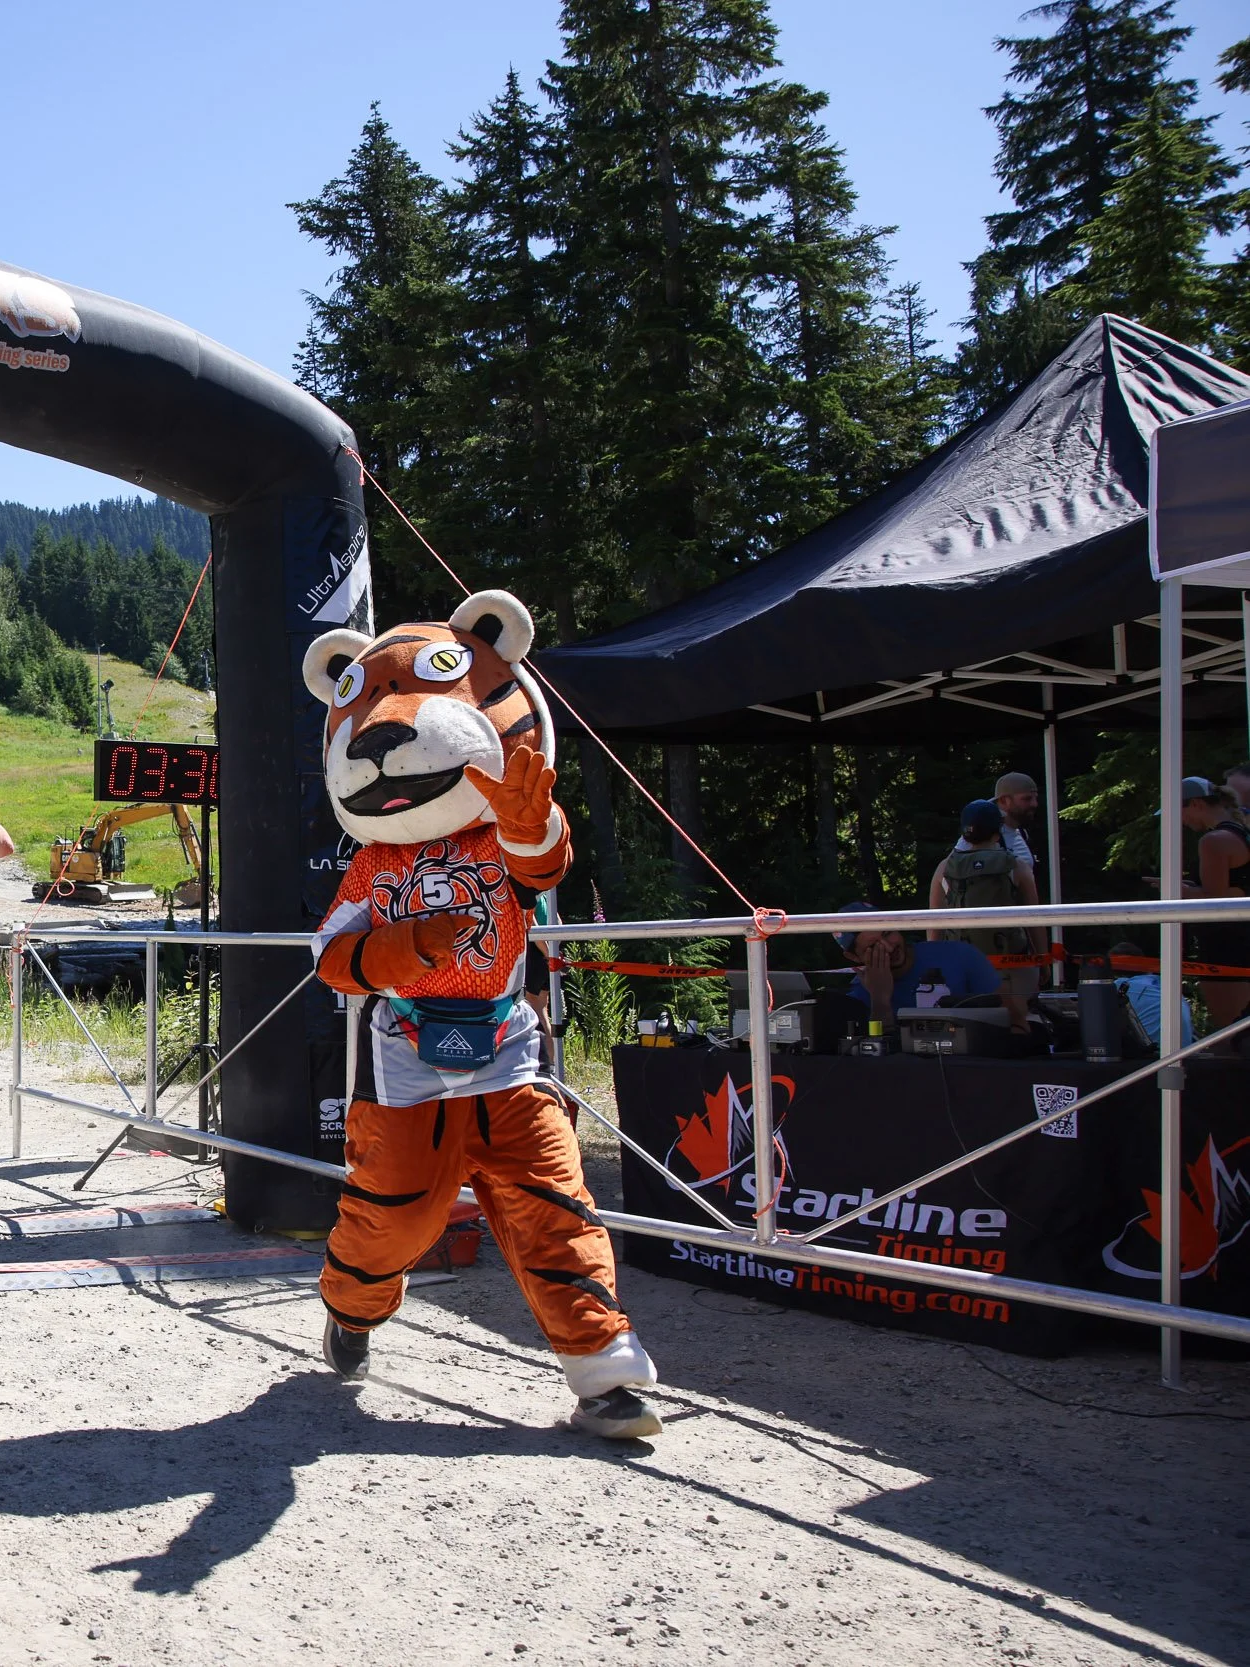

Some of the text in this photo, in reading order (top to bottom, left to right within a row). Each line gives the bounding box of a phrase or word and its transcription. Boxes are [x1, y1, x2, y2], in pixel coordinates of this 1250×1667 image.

[24, 349, 69, 371] series
[297, 524, 365, 614] UltrAspire
[309, 858, 332, 870] LA
[420, 872, 454, 911] 5
[320, 1122, 346, 1131] SCR
[735, 1173, 1007, 1237] Startline
[876, 1234, 1006, 1275] Timing
[670, 1240, 1010, 1324] StartlineTiming.com
